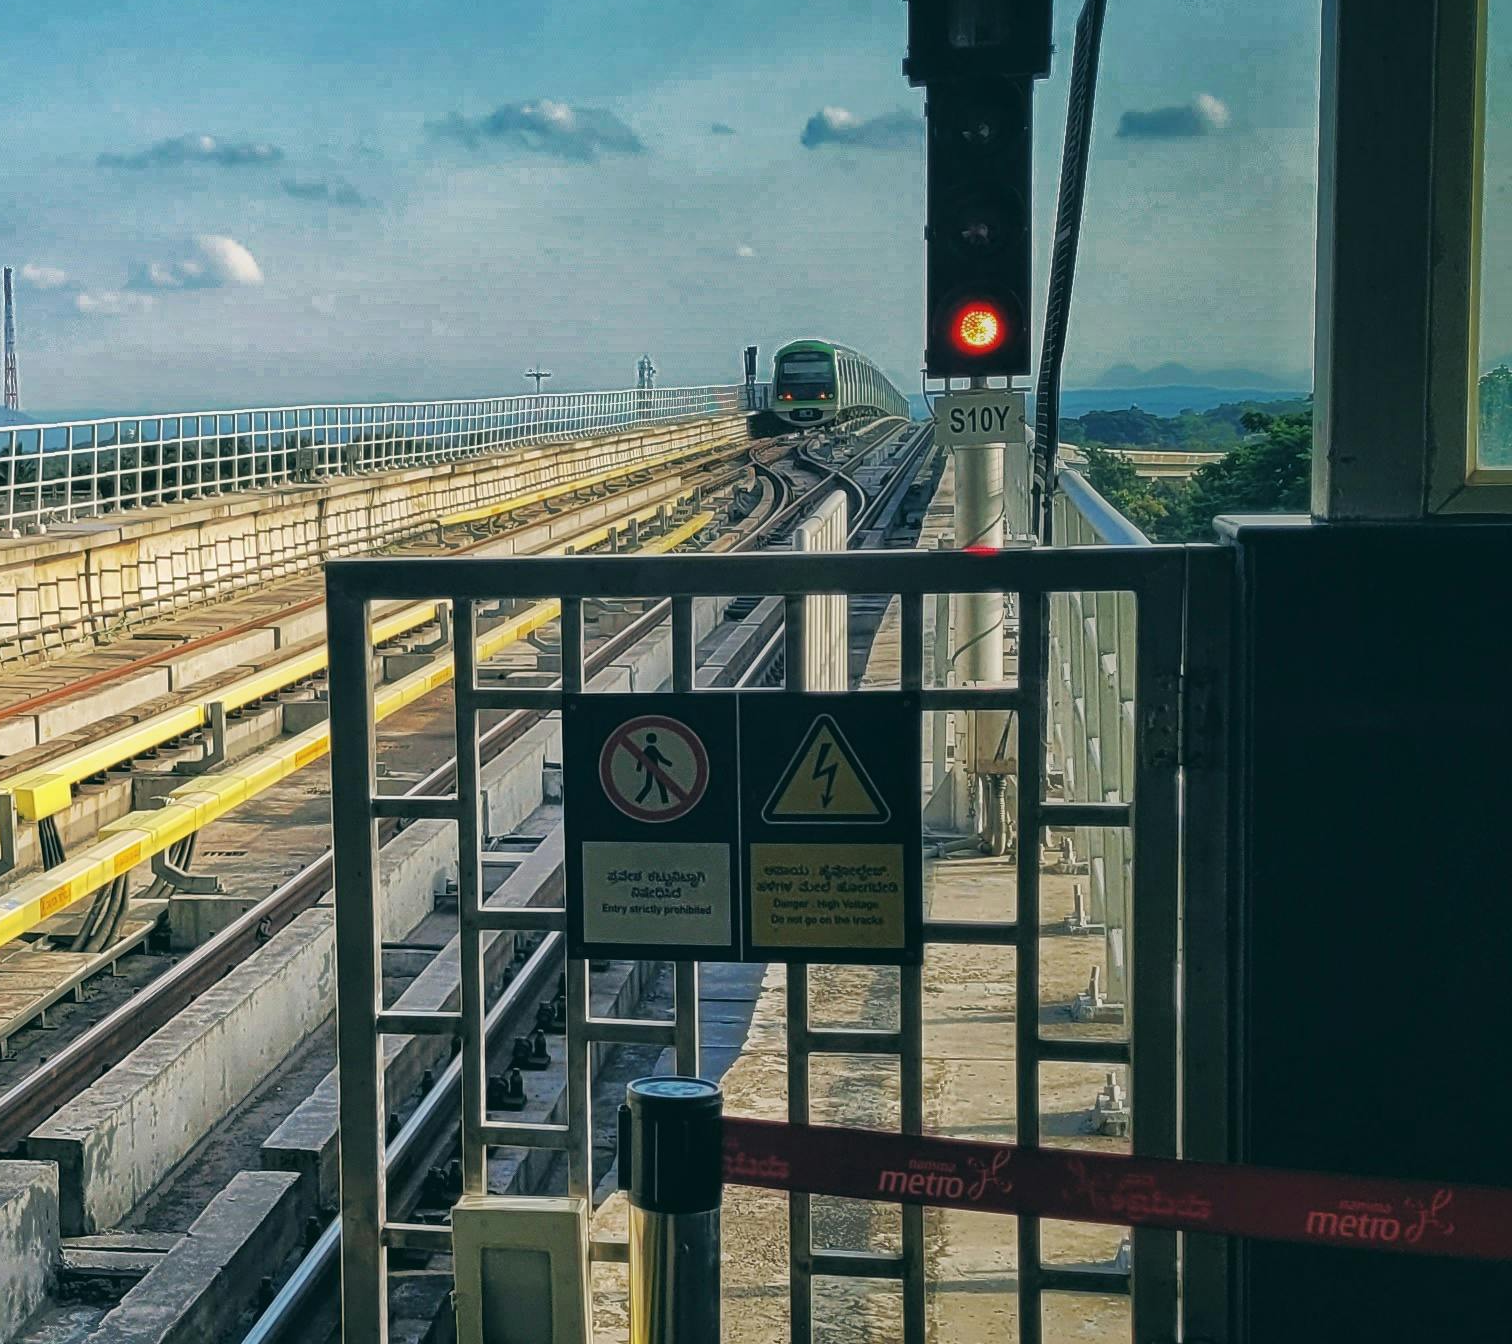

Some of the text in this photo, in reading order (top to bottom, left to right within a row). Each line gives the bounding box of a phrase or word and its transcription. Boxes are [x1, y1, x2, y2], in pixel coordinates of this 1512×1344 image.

[949, 406, 1011, 434] S10Y
[601, 903, 712, 917] Entry strictly prohibited
[816, 898, 841, 911] High
[842, 898, 879, 911] Voltage
[771, 913, 884, 927] Do not go on the tracks
[877, 1169, 965, 1199] metro
[1303, 1210, 1401, 1242] metro
